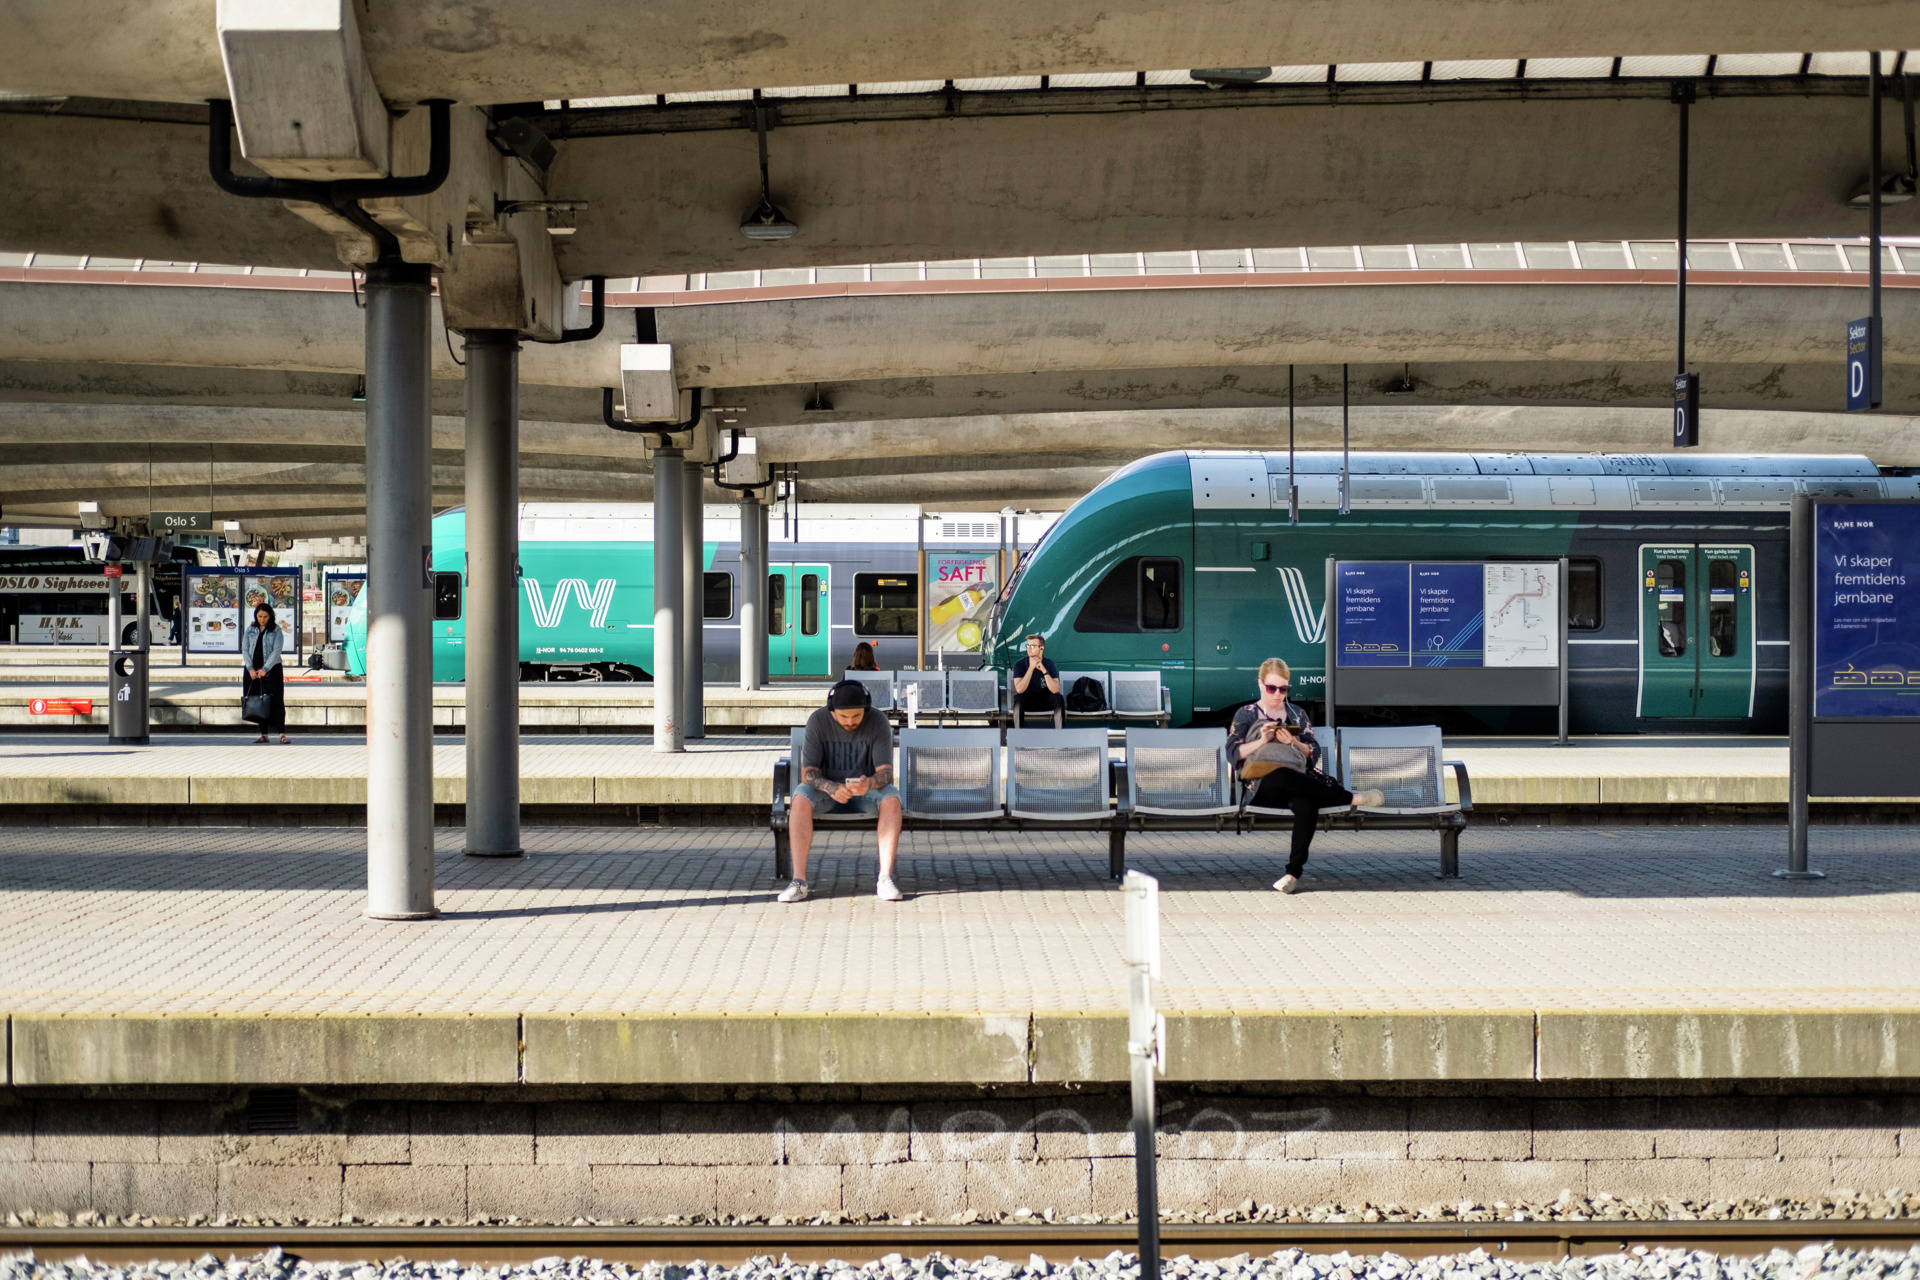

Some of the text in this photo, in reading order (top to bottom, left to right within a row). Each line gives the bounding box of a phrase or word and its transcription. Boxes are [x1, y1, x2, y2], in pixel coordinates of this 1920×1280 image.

[1849, 326, 1866, 340] Sektor
[1852, 361, 1864, 398] D
[1676, 407, 1685, 437] D
[165, 516, 196, 526] Oslo S
[1834, 521, 1854, 529] BANE
[1834, 554, 1893, 570] Vi skaper
[938, 566, 987, 581] SAFT
[1835, 572, 1906, 585] fremtidens
[0, 576, 40, 589] OSLO
[42, 576, 130, 592] Sightseeig
[1353, 588, 1374, 596] skaper
[1428, 588, 1449, 596] skaper
[1834, 591, 1894, 606] jernbane
[1345, 605, 1375, 613] jernbane
[1420, 605, 1449, 614] jernbane
